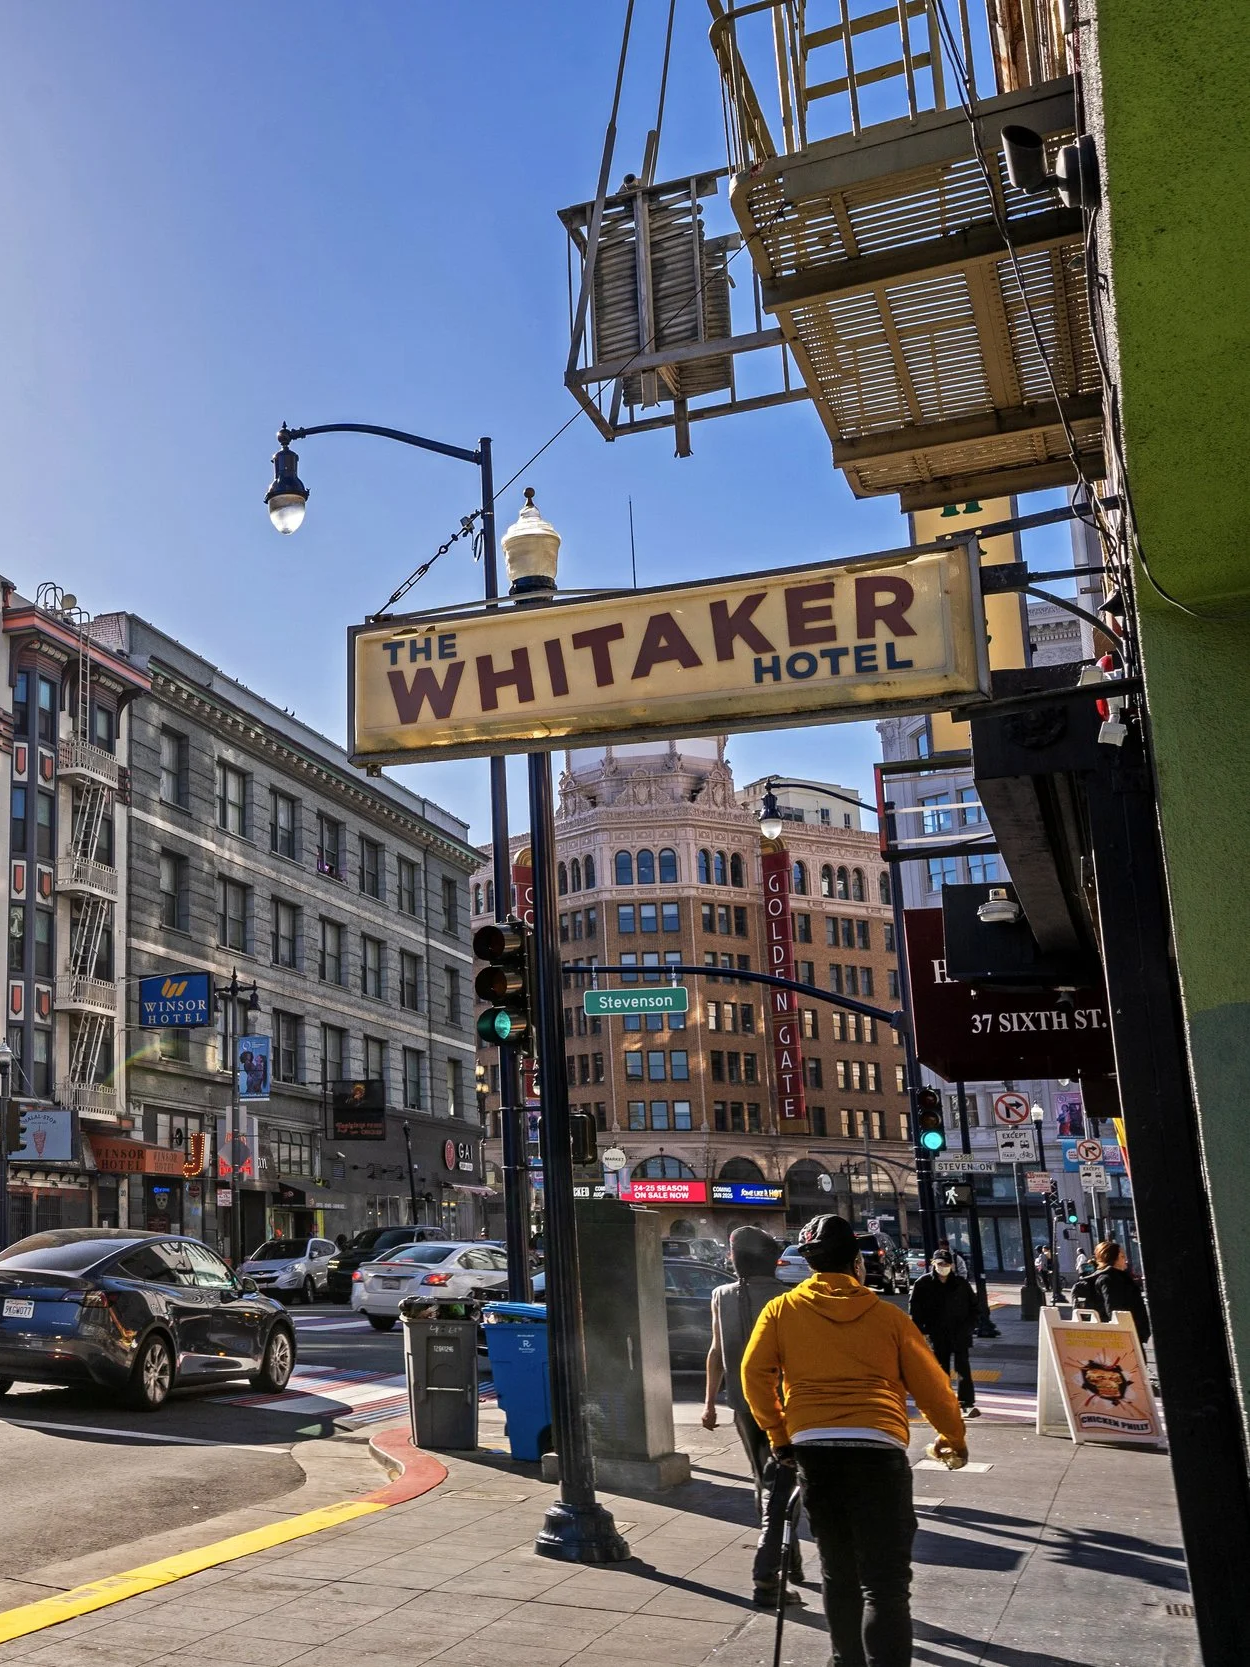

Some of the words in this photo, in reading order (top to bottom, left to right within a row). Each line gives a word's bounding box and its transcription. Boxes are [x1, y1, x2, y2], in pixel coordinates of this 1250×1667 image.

[382, 633, 457, 666] THE
[387, 576, 918, 725] WHITAKER
[753, 641, 914, 684] HOTEL
[144, 1000, 206, 1012] WINSOR
[599, 996, 673, 1009] Stevenson
[148, 1013, 202, 1024] HOTEL
[971, 1014, 992, 1034] 37
[999, 1011, 1069, 1032] SIXTH
[1074, 1009, 1108, 1030] ST.
[779, 1026, 795, 1118] GATE
[96, 1149, 144, 1160] WINSOR
[459, 1142, 472, 1159] GAI
[101, 1160, 142, 1171] HOTEL
[938, 1162, 993, 1171] STEVENON
[1081, 1416, 1120, 1428] CHICKEN
[1121, 1420, 1149, 1431] PHILLY
